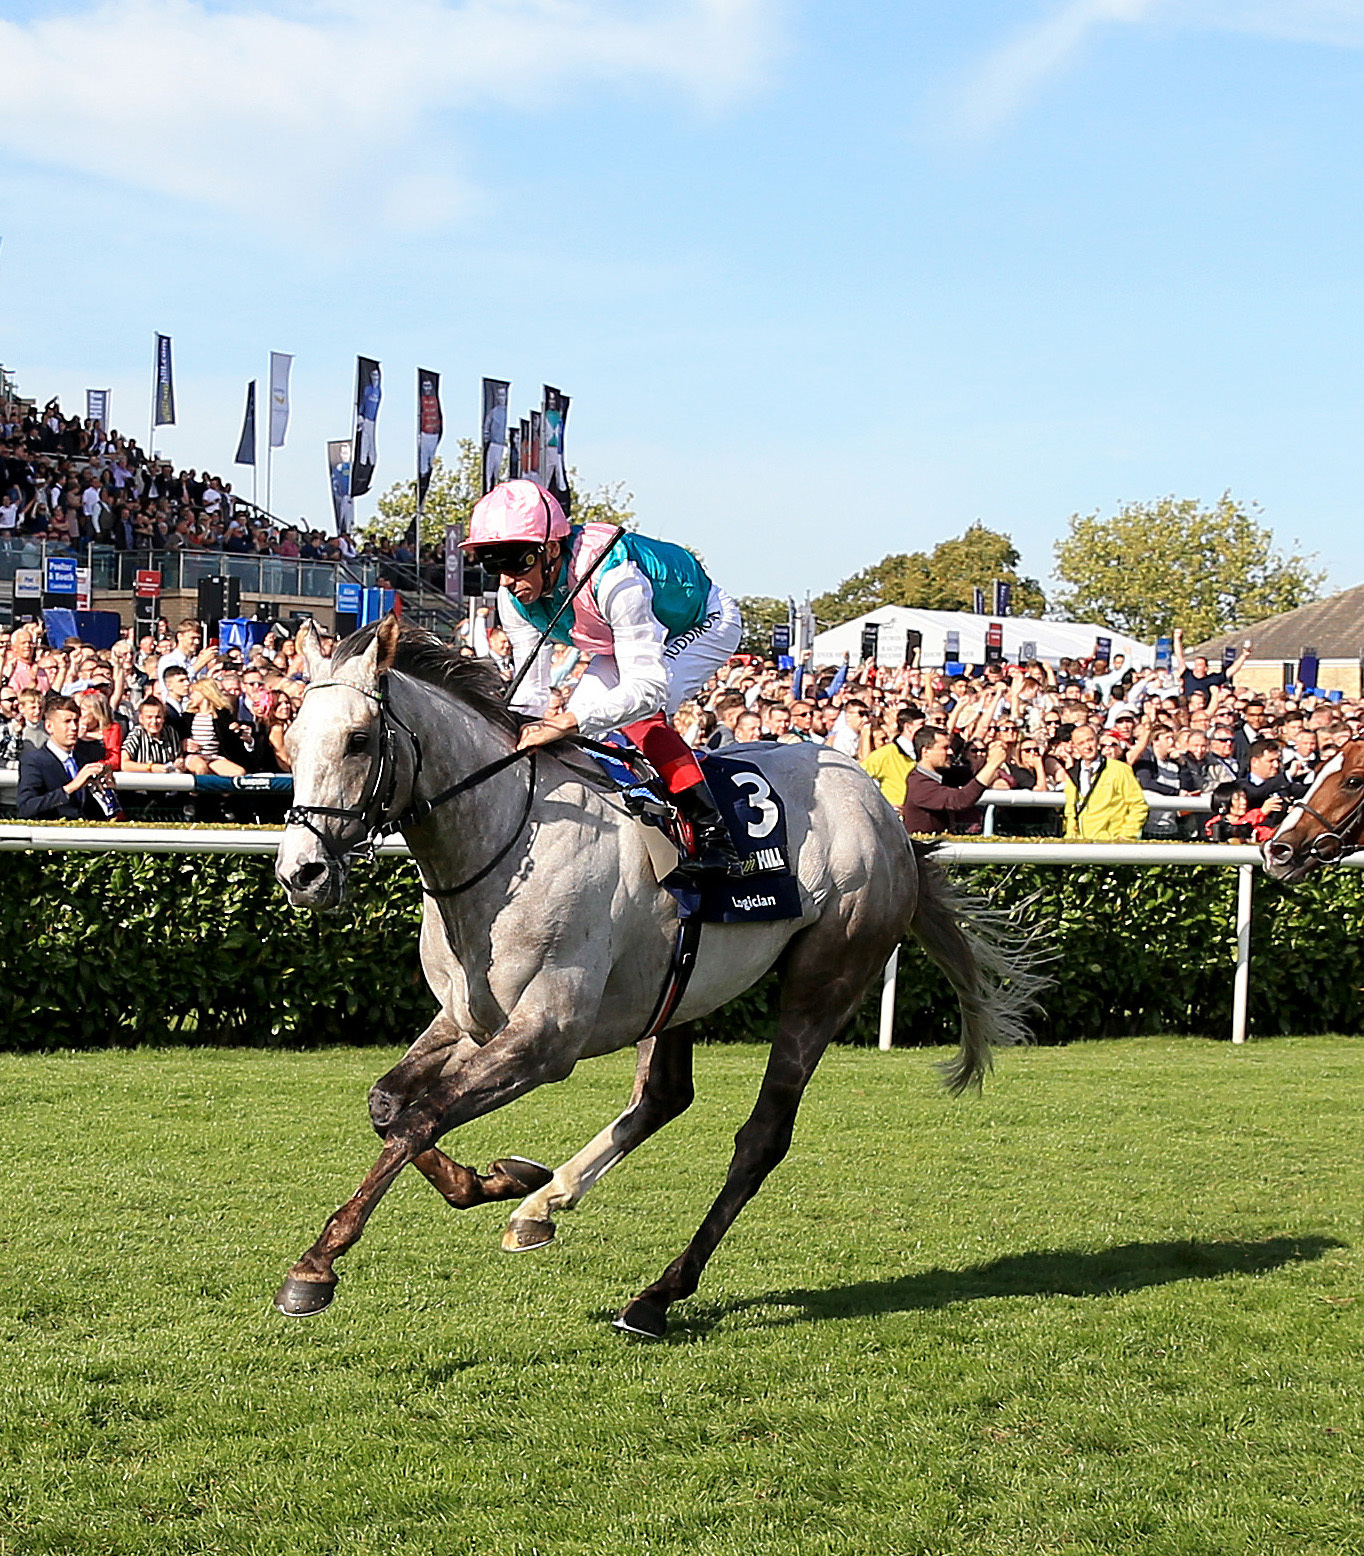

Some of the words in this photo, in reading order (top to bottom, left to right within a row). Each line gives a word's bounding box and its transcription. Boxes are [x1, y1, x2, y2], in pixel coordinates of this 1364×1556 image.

[730, 771, 779, 838] 3
[756, 847, 785, 870] HILL
[731, 894, 777, 911] Logician
